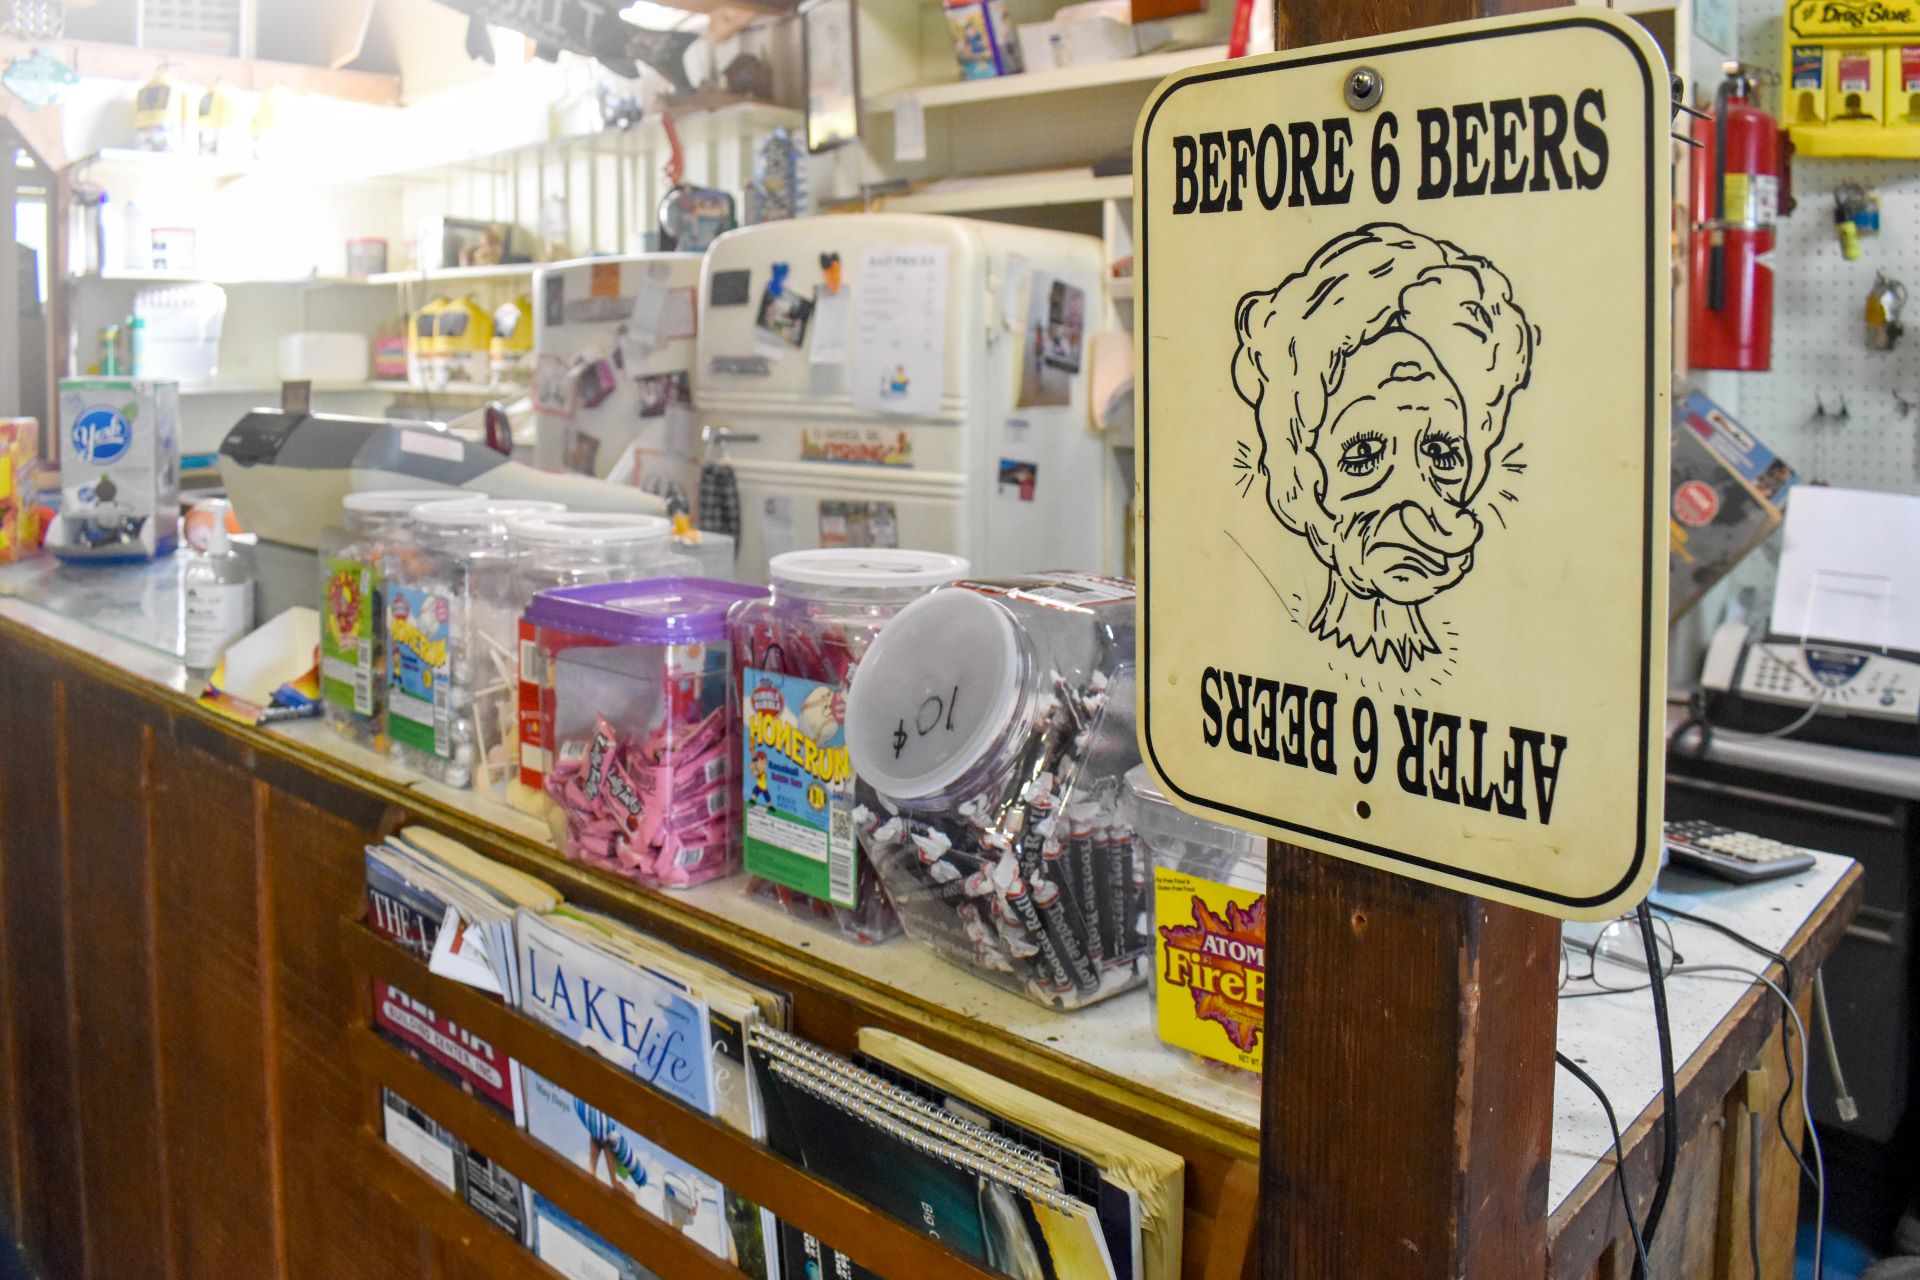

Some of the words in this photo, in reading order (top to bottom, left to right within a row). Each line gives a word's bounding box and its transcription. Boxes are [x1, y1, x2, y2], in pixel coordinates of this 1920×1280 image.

[1172, 117, 1355, 215] BEFORE
[1371, 111, 1400, 204] 6
[1417, 88, 1609, 200] BEERS
[749, 711, 850, 785] HOMERUN
[1200, 666, 1338, 775] BEERS
[1352, 696, 1379, 784] 6
[1394, 704, 1568, 826] AFTER
[370, 889, 414, 945] THE
[1016, 895, 1041, 931] Roll
[1050, 901, 1080, 959] Tootsie
[1073, 954, 1098, 991] Roll
[1036, 929, 1068, 986] Tootsie
[1203, 934, 1264, 967] ATOM
[388, 1005, 432, 1040] BUILDING
[528, 947, 639, 1056] LAKE
[920, 1201, 935, 1227] Big
